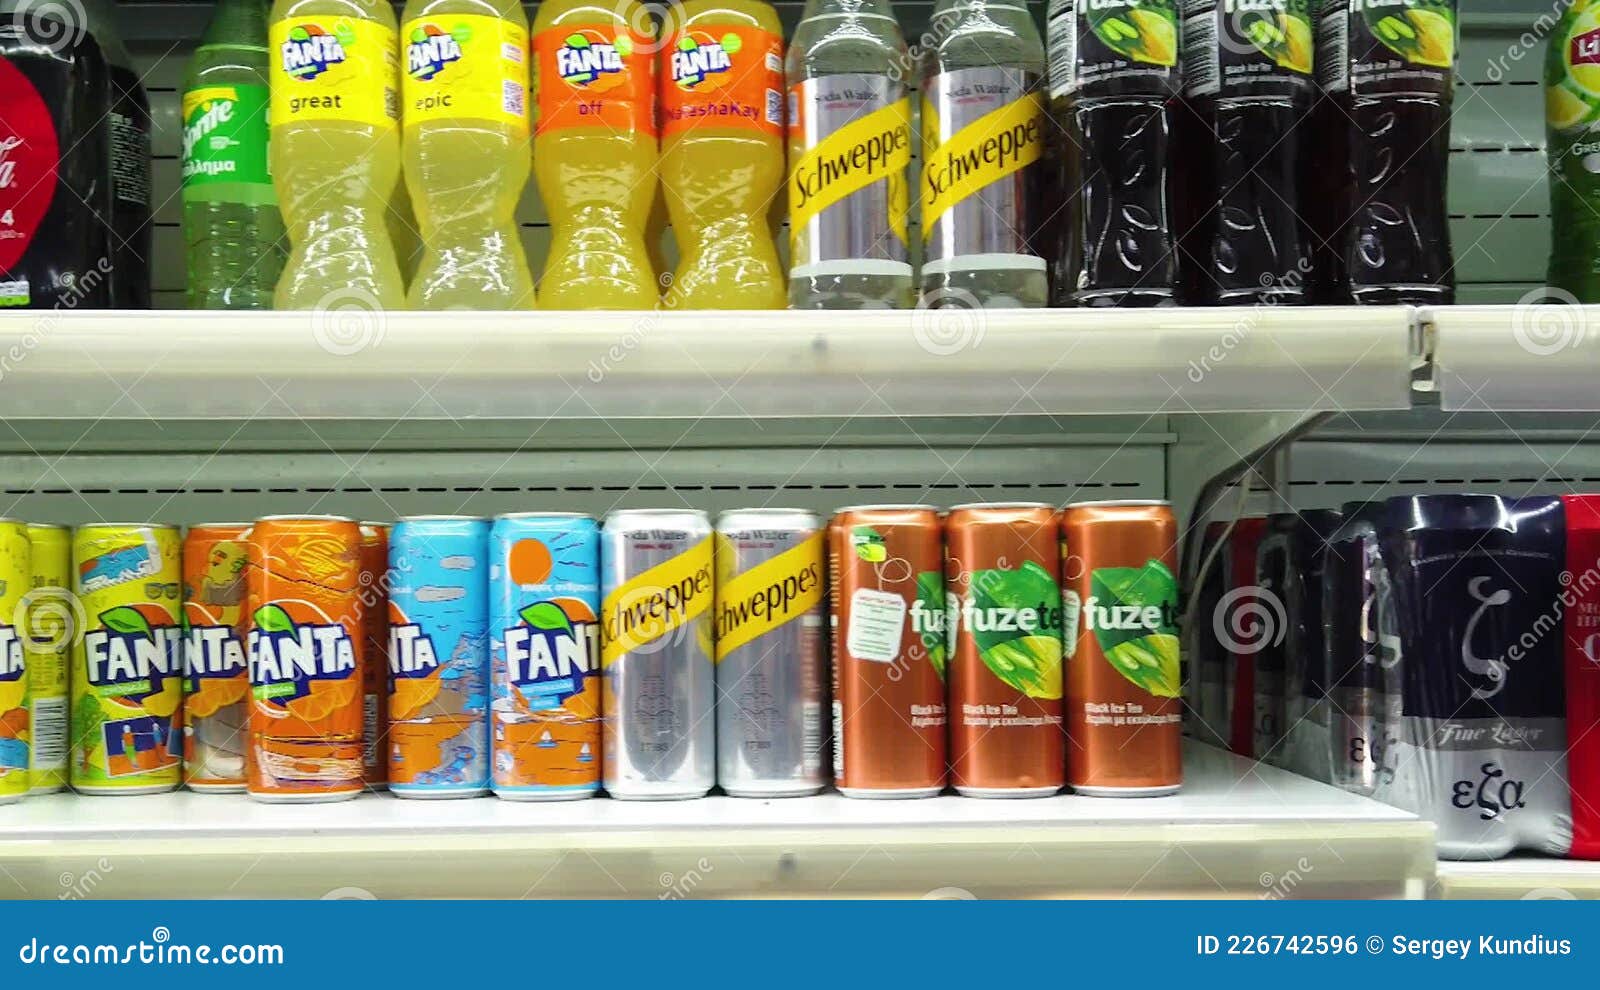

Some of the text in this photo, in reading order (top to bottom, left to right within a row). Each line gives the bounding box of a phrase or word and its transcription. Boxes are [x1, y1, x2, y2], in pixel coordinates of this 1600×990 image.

[556, 44, 625, 77] FANTA
[290, 95, 342, 113] great
[416, 92, 452, 111] epic
[717, 562, 818, 642] chweppes
[248, 626, 356, 684] FANTA
[1439, 724, 1486, 747] Fine
[1452, 762, 1527, 820] εζα
